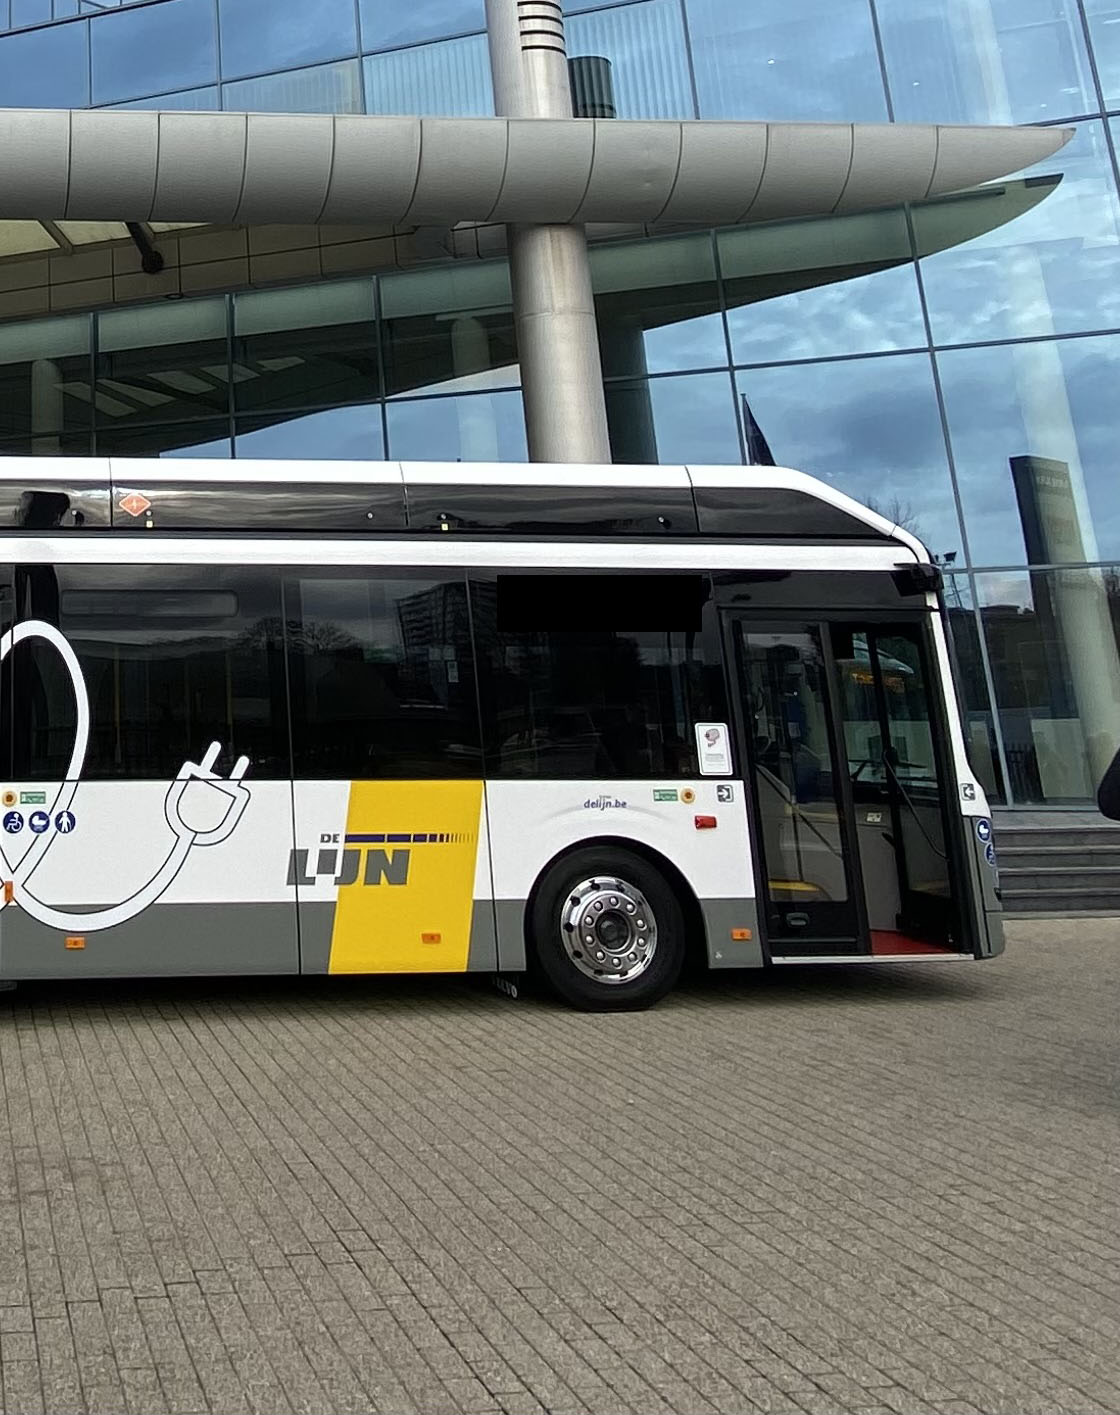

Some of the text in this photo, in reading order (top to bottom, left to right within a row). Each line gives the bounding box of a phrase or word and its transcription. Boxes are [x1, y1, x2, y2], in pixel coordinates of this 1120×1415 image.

[584, 797, 627, 811] delijn.be
[320, 833, 341, 844] DE
[286, 849, 411, 886] LIJN
